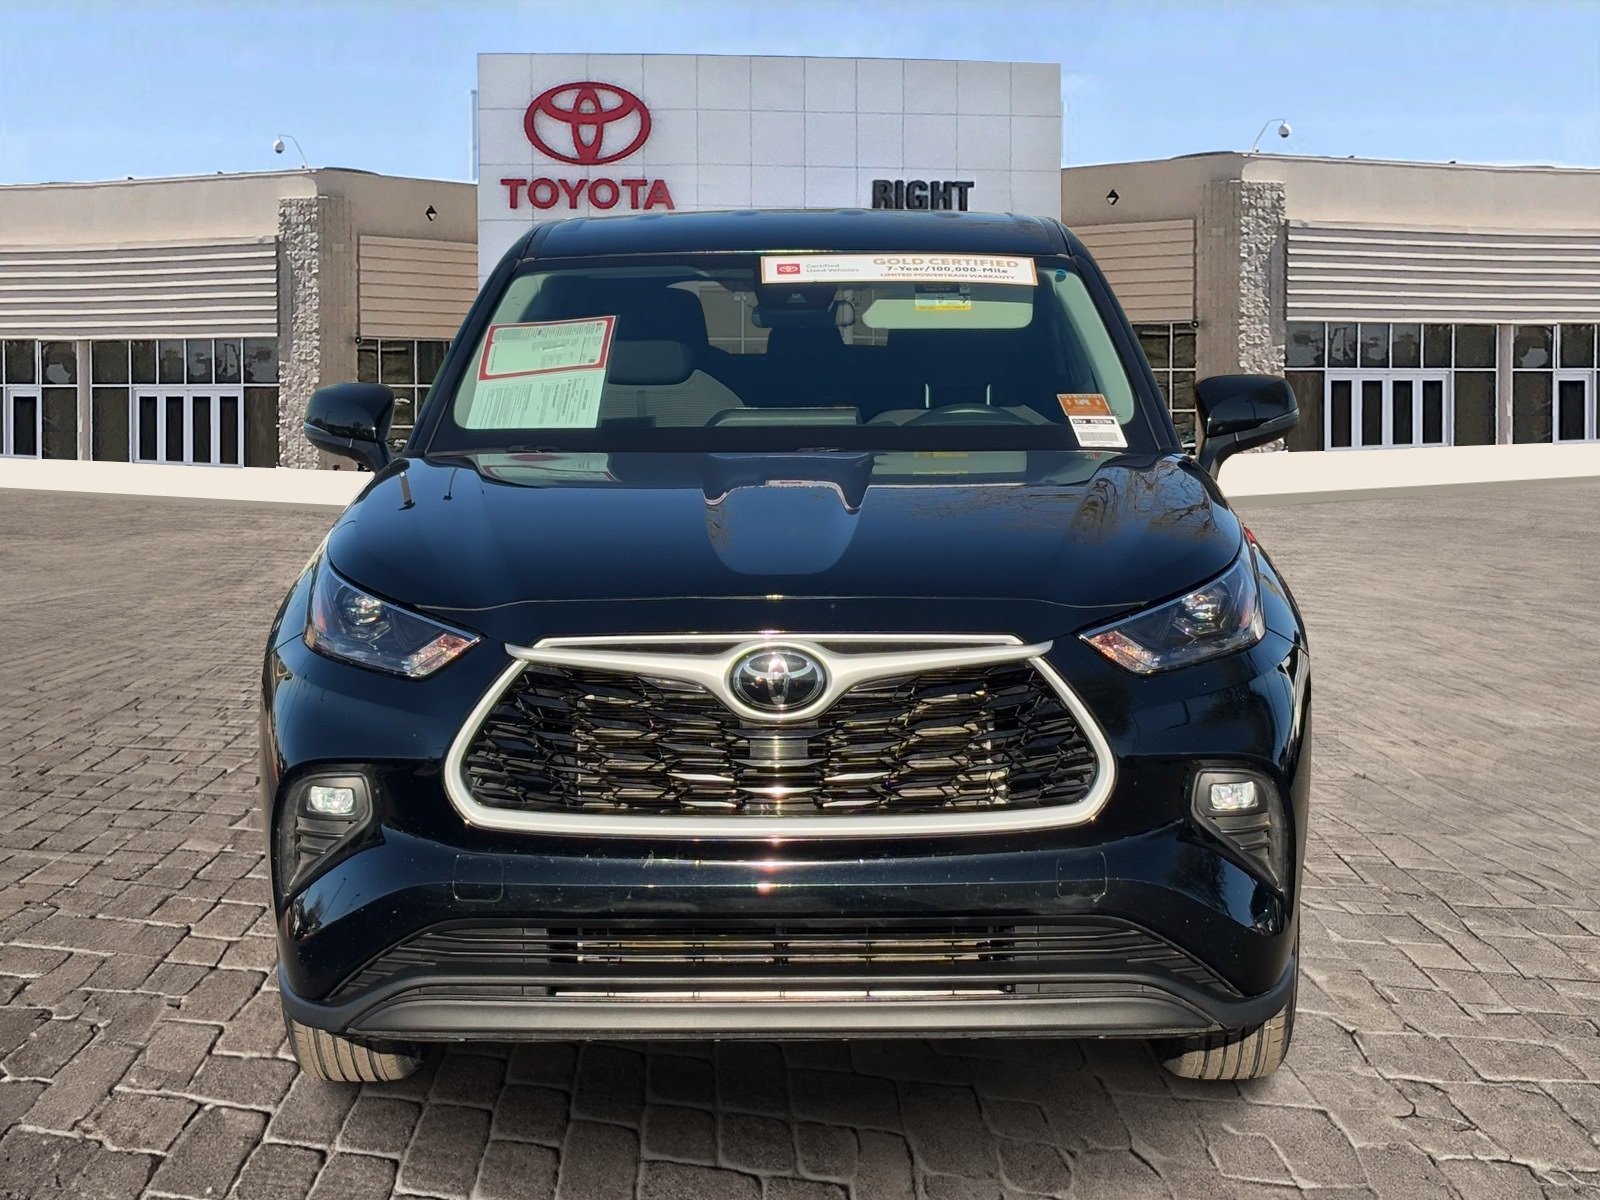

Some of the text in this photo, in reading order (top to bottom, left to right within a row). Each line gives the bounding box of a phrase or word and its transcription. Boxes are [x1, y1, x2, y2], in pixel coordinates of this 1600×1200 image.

[500, 177, 675, 210] TOYOTA
[872, 179, 975, 211] RIGHT
[873, 257, 1019, 268] GOLD CERTIFIED
[886, 265, 1008, 274] 7-Year/100,000-Mile
